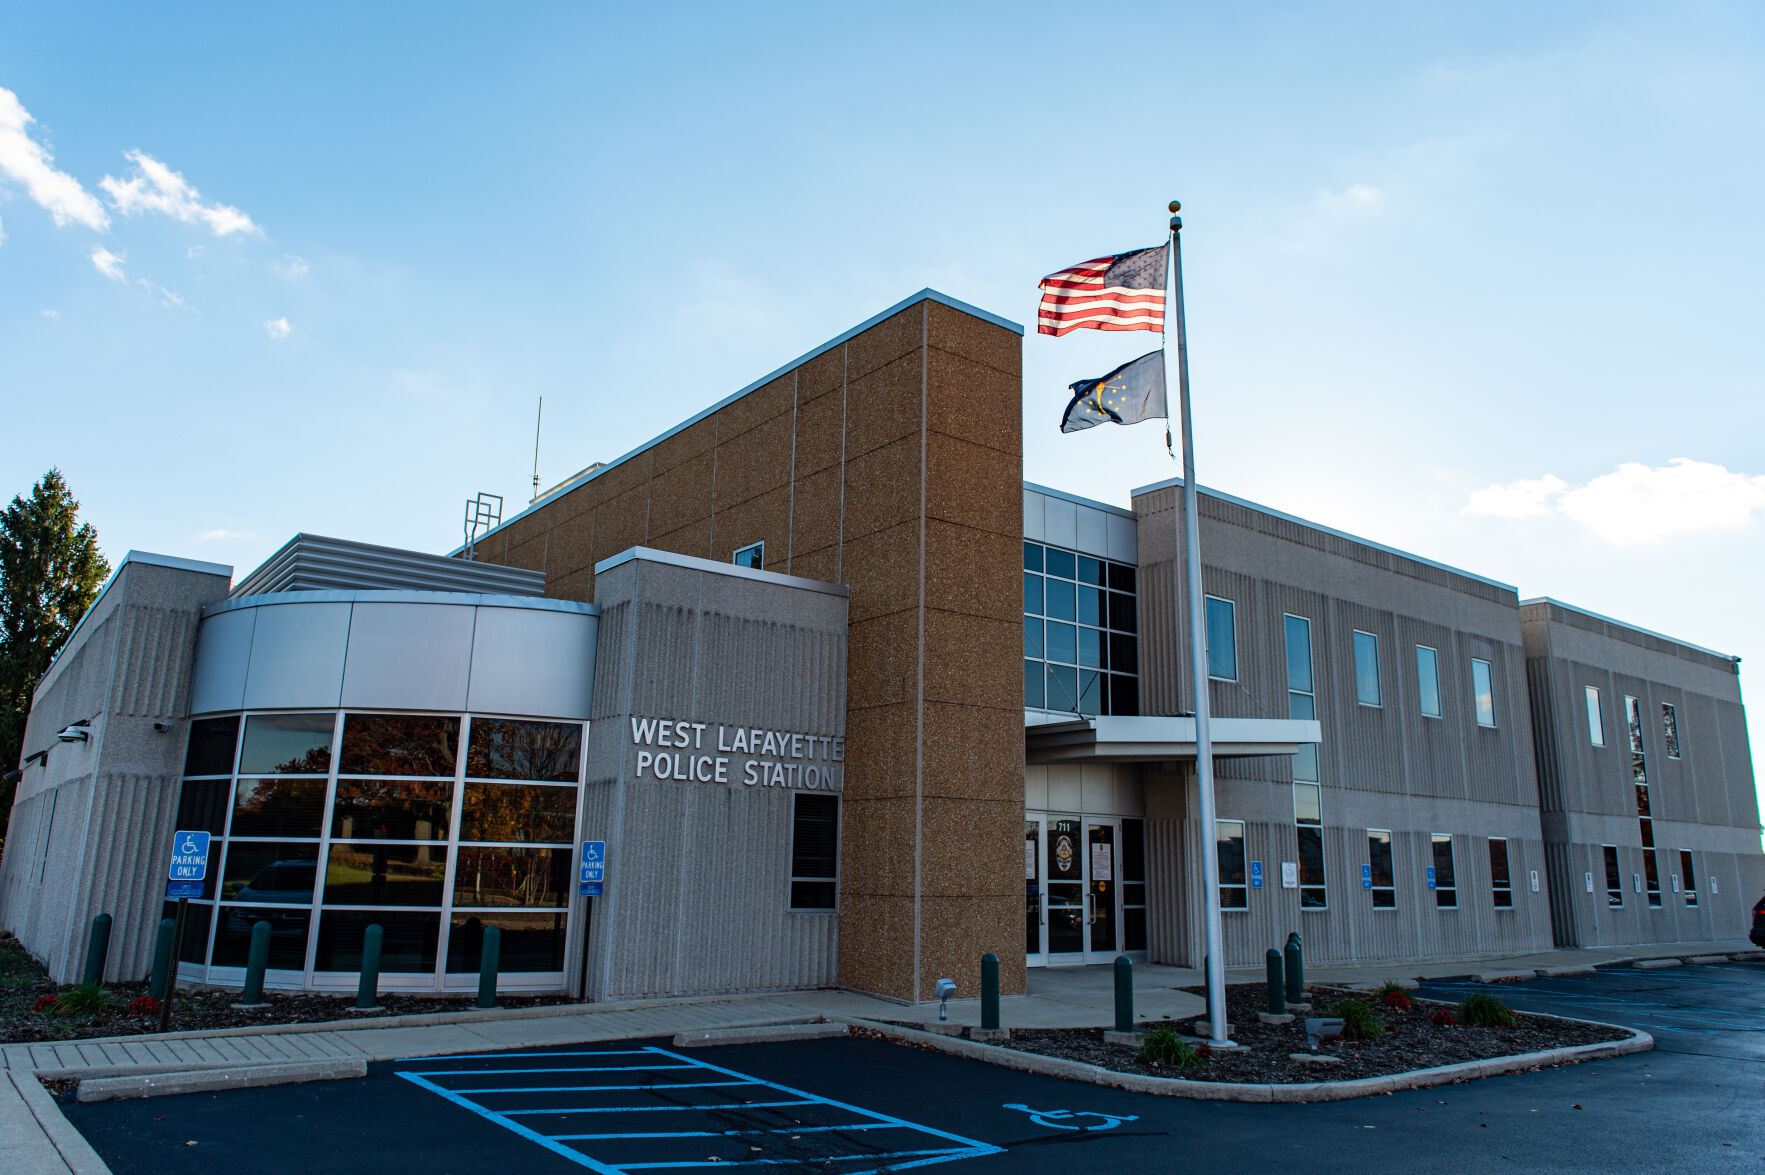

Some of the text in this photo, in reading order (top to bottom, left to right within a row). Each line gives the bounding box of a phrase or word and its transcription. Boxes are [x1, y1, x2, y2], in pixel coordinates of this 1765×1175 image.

[631, 717, 844, 762] WEST LAFAYETTE
[636, 750, 836, 791] POLICE STATION
[1058, 822, 1070, 832] 711
[172, 855, 206, 865] PARKING
[582, 861, 604, 869] PARKING
[177, 866, 197, 877] ONLY
[585, 870, 598, 879] ONLY
